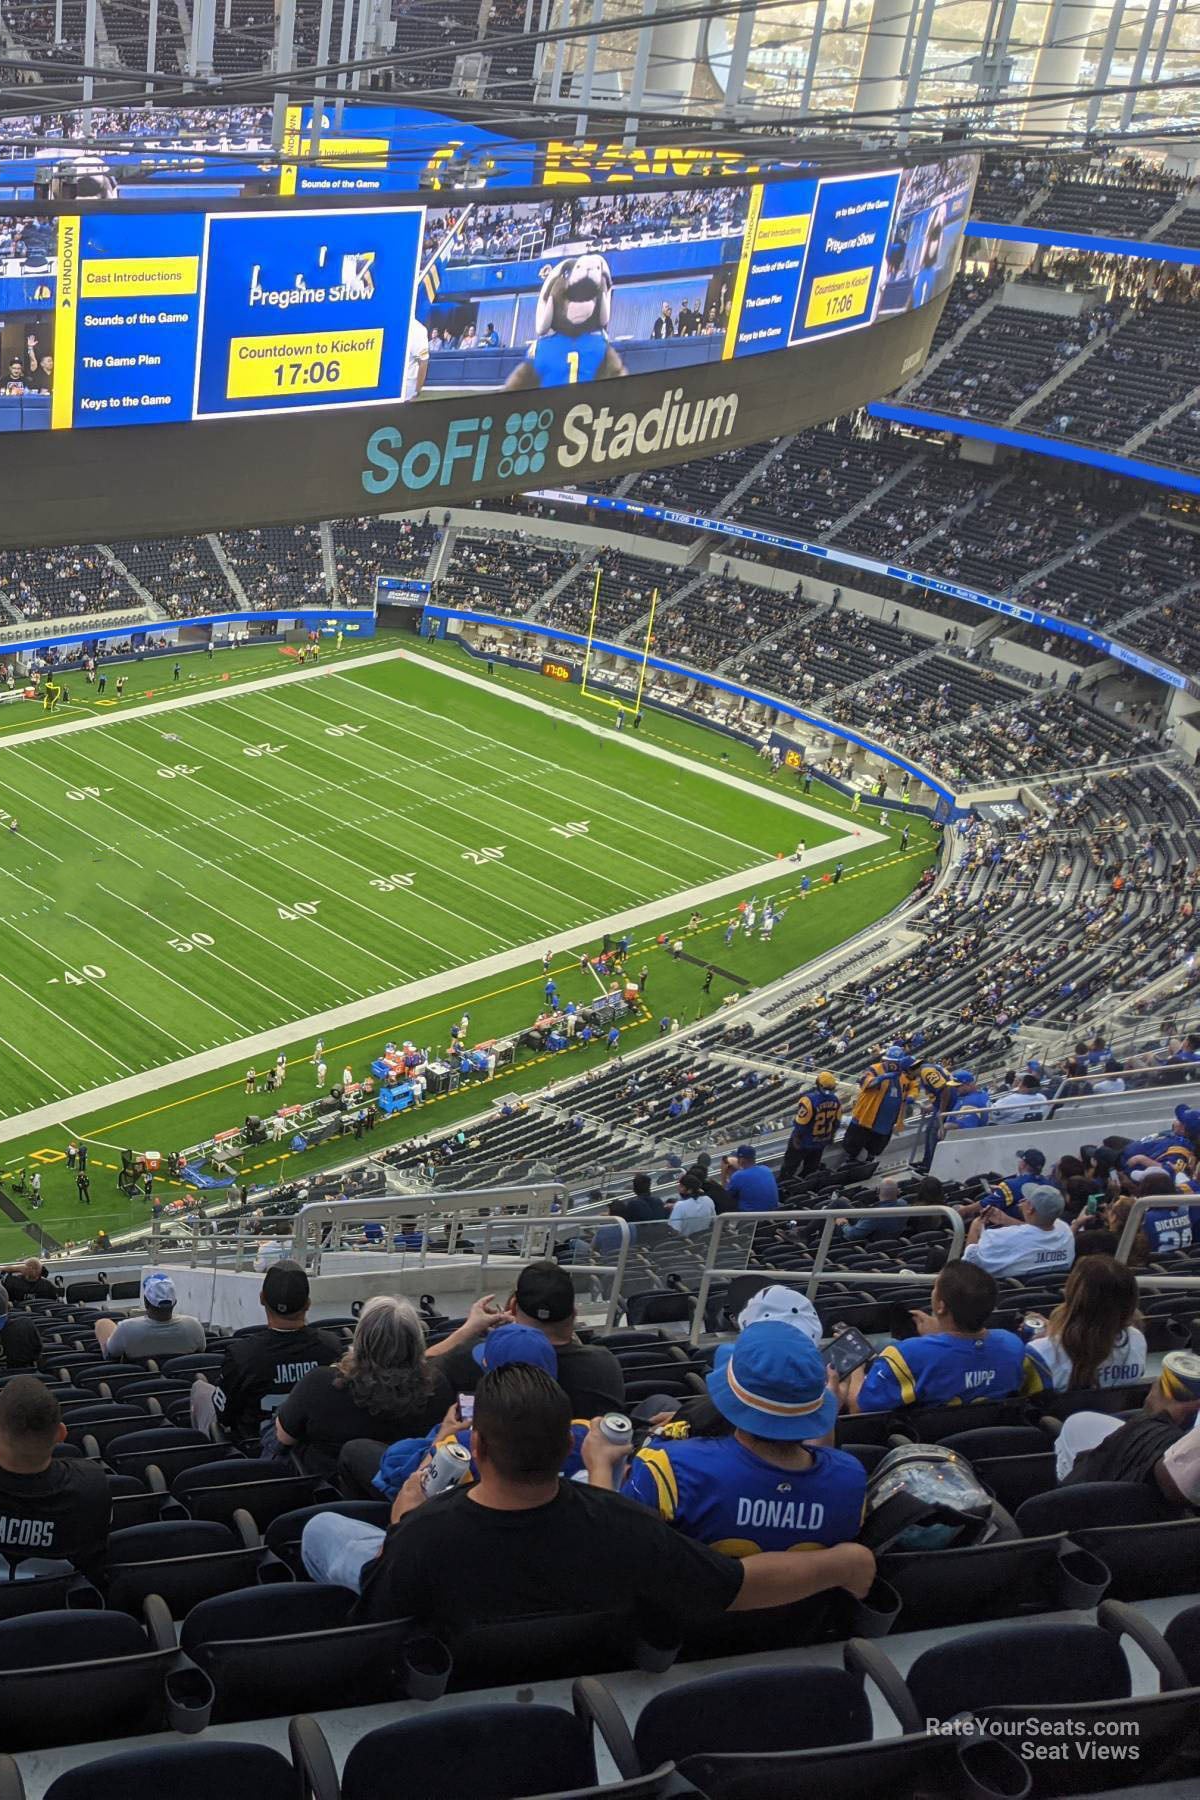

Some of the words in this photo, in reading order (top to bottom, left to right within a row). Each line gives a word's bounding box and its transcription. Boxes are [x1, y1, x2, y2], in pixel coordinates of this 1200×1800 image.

[301, 180, 330, 189] Sounds
[332, 180, 341, 188] of
[342, 180, 354, 188] the
[356, 180, 380, 189] Game
[63, 227, 74, 295] RUNDOWN
[86, 273, 111, 283] Cast
[113, 270, 182, 283] Introductions
[814, 281, 845, 295] Countdown
[846, 279, 852, 289] to
[852, 275, 869, 288] Kickoff
[249, 287, 325, 309] Pregame
[329, 285, 375, 301] Show
[826, 293, 853, 316] 17:06
[84, 315, 124, 326] Sounds
[126, 313, 137, 324] of
[139, 312, 156, 323] the
[158, 312, 189, 323] Game
[239, 344, 312, 360] Countdown
[316, 342, 328, 354] to
[331, 338, 376, 353] Kickoff
[83, 357, 103, 368] The
[105, 357, 137, 367] Game
[138, 355, 161, 366] Plan
[274, 360, 341, 387] 17:06
[81, 398, 108, 411] Keys
[109, 397, 120, 408] to
[122, 396, 139, 407] the
[140, 395, 172, 406] Game
[362, 416, 493, 495] SoFi
[557, 388, 739, 468] Stadium
[324, 723, 363, 737] 10
[242, 742, 281, 758] 20
[157, 764, 196, 779] 30
[65, 786, 102, 802] 40
[549, 821, 590, 839] 10
[461, 847, 505, 865] 20
[369, 873, 415, 892] 30
[277, 902, 318, 921] 40
[166, 932, 216, 953] 50
[64, 964, 107, 987] 40
[1034, 1249, 1068, 1264] JACOBS
[964, 1369, 996, 1389] KUPP
[736, 1497, 824, 1530] DONALD
